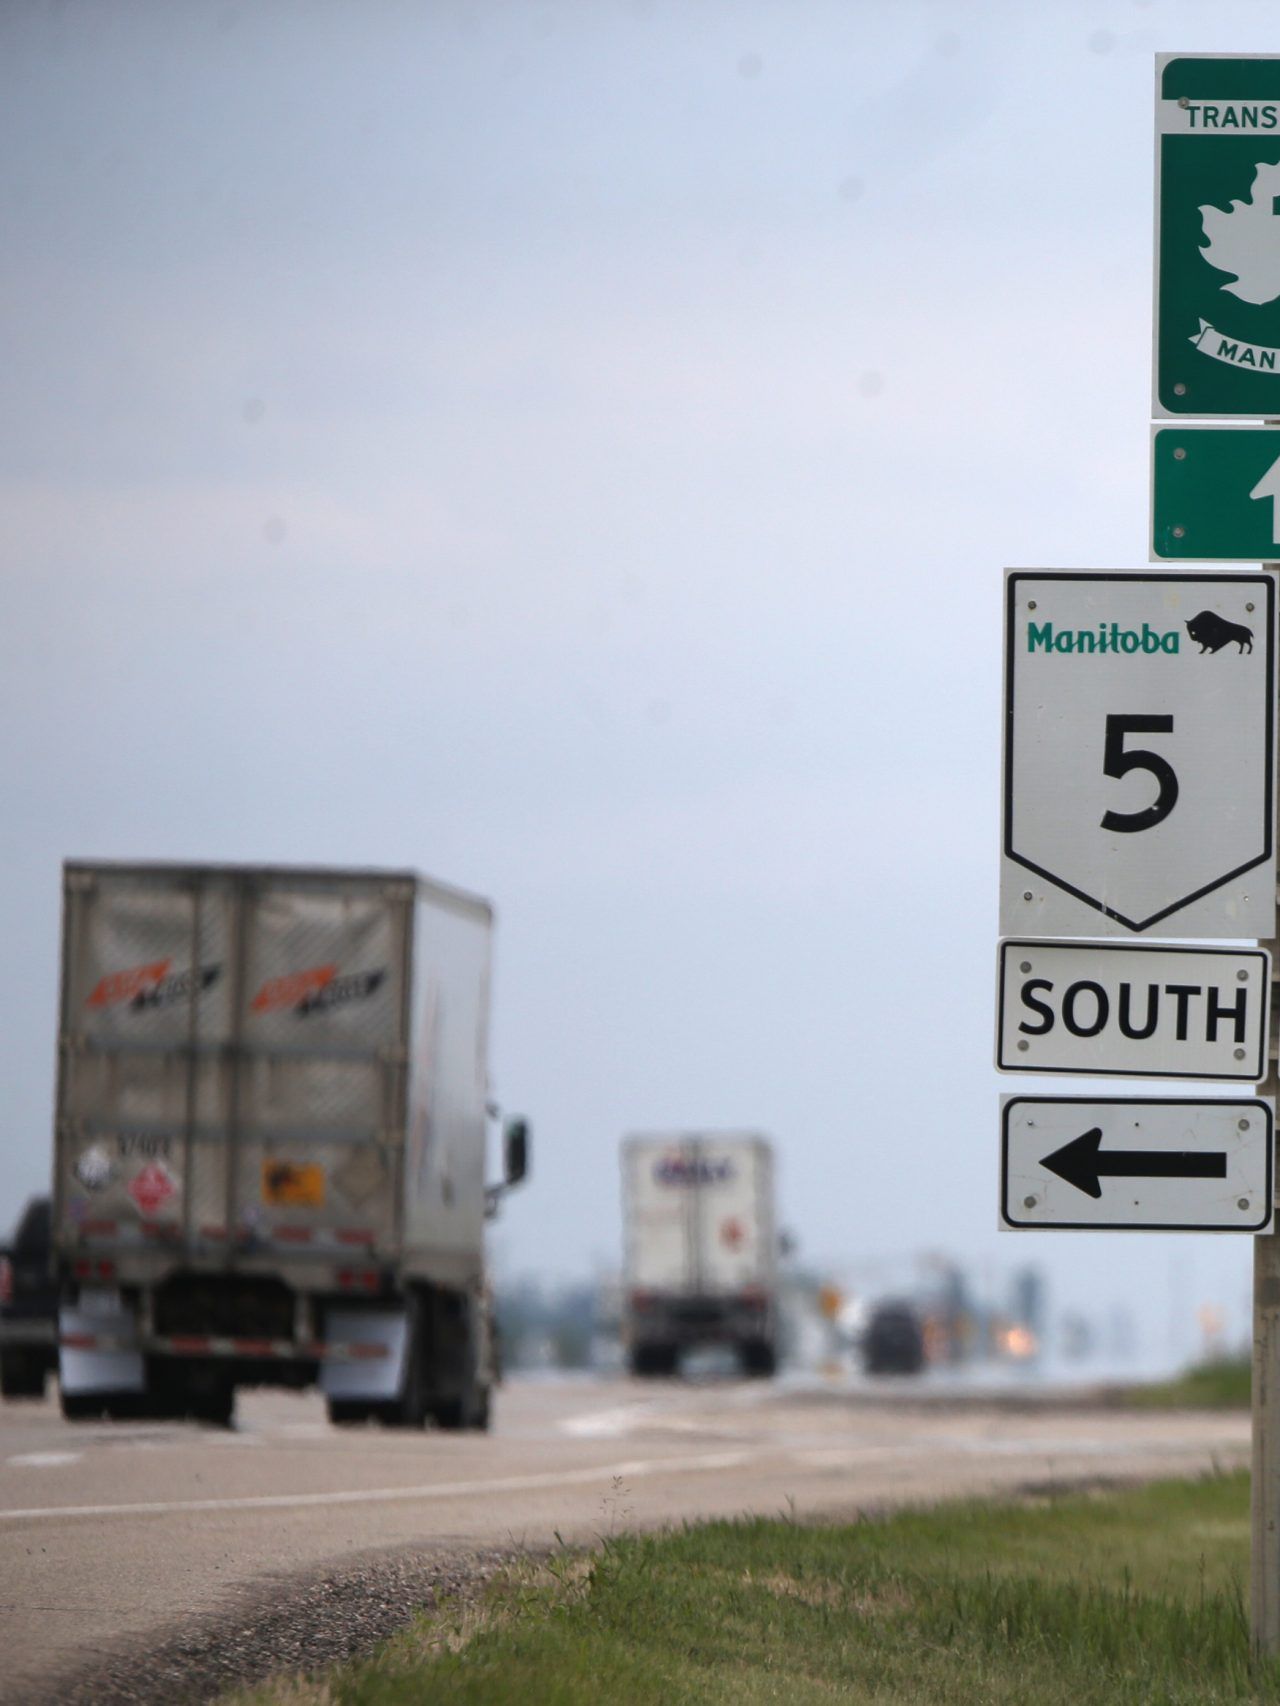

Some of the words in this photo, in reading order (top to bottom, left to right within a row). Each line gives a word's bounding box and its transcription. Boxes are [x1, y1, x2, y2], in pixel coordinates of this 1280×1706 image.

[1186, 105, 1278, 129] TRANS
[1027, 621, 1180, 654] Manitoba
[1100, 714, 1179, 833] 5
[1018, 978, 1248, 1043] SOUTH
